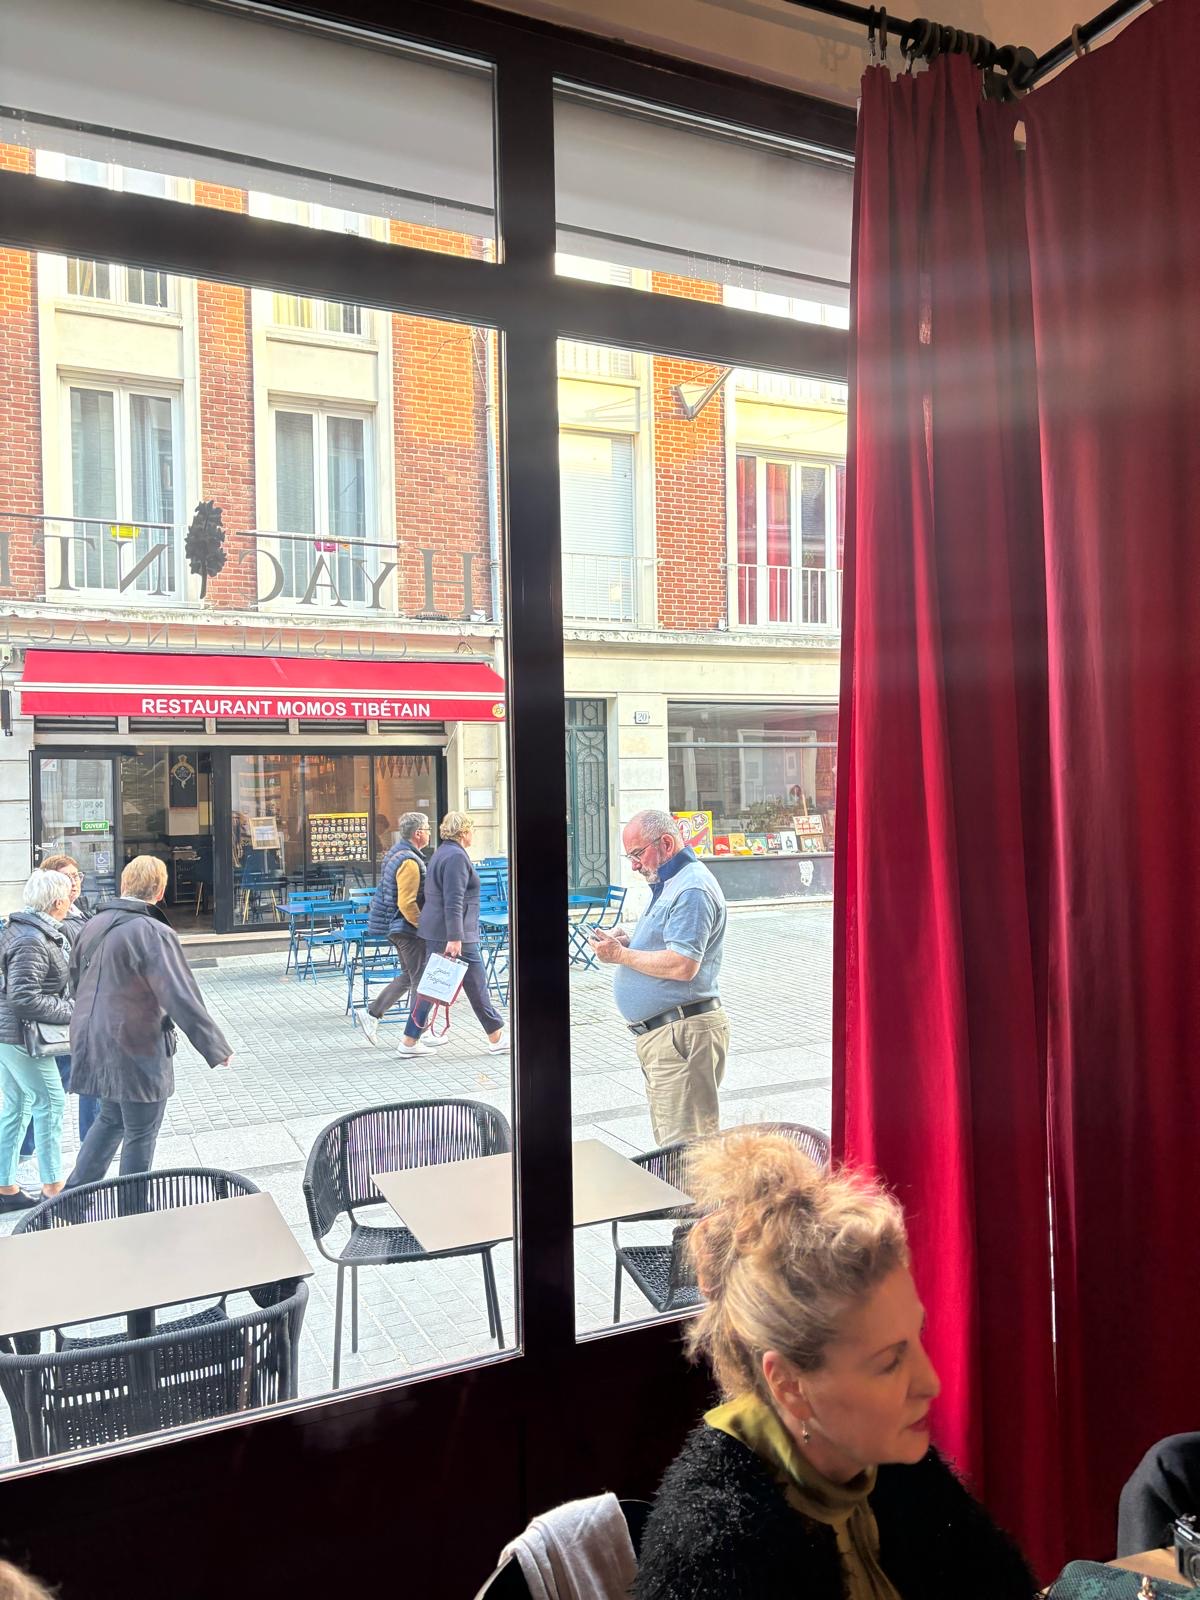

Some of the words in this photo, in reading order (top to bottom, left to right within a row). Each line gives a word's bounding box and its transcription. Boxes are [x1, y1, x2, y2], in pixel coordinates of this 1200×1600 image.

[141, 698, 272, 715] RESTAURANT
[277, 701, 347, 717] MOMOS
[353, 700, 431, 717] TIBÉTAIN
[84, 822, 106, 830] OUVERT
